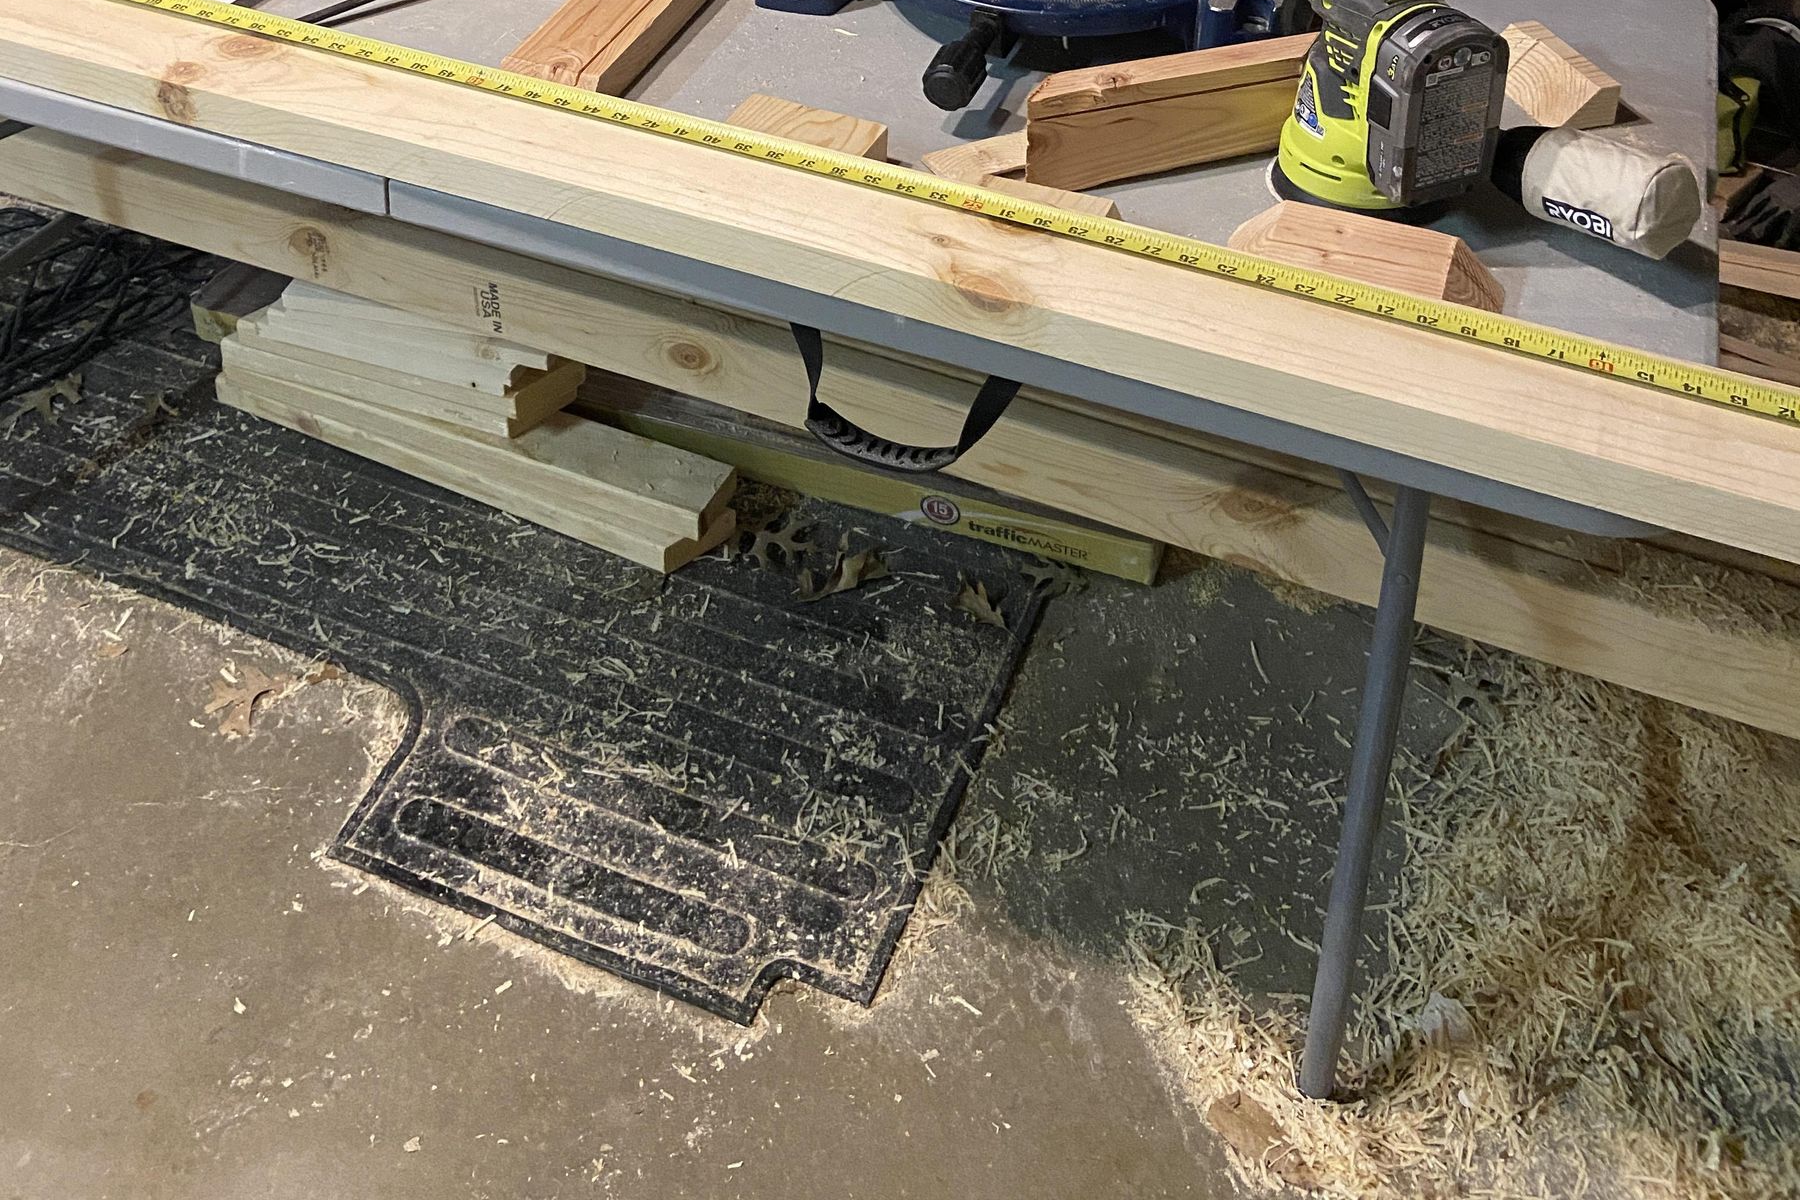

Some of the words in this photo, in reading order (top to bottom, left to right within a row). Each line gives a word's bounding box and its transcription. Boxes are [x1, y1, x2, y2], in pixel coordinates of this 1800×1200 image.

[171, 3, 188, 12] 59
[196, 9, 214, 18] 58
[223, 16, 239, 25] 57
[250, 23, 267, 31] 56
[276, 29, 293, 38] 55
[301, 36, 319, 44] 54
[328, 42, 346, 51] 53
[355, 49, 373, 58] 52
[384, 56, 400, 64] 51
[410, 62, 428, 71] 50
[437, 69, 455, 78] 49
[495, 83, 513, 92] 47
[553, 98, 571, 106] 45
[582, 105, 601, 114] 44
[611, 112, 630, 121] 43
[641, 119, 660, 128] 42
[673, 127, 689, 136] 41
[702, 135, 722, 144] 40
[734, 142, 752, 152] 39
[765, 150, 784, 160] 38
[798, 159, 816, 168] 37
[863, 174, 882, 185] 35
[895, 183, 915, 193] 34
[929, 191, 949, 201] 33
[962, 200, 984, 211] 32
[999, 209, 1016, 218] 31
[1033, 217, 1052, 227] 30
[1545, 201, 1611, 237] RYOBI
[1067, 226, 1089, 237] 29
[1104, 235, 1125, 246] 28
[1140, 245, 1162, 256] 27
[1178, 254, 1199, 265] 26
[1217, 263, 1238, 275] 25
[1255, 274, 1276, 285] 24
[1294, 283, 1316, 294] 23
[480, 290, 491, 318] USA
[488, 282, 501, 319] MADE
[1334, 293, 1357, 305] 22
[1377, 304, 1395, 315] 21
[1416, 314, 1439, 326] 20
[492, 320, 503, 333] IN
[1460, 326, 1478, 337] 19
[1503, 337, 1520, 348] 18
[1547, 349, 1564, 359] 17
[1636, 371, 1655, 382] 15
[1683, 382, 1702, 394] 14
[1729, 394, 1748, 406] 13
[1778, 406, 1796, 419] 12
[933, 502, 948, 515] 15
[968, 520, 1088, 560] trafficMASTER
